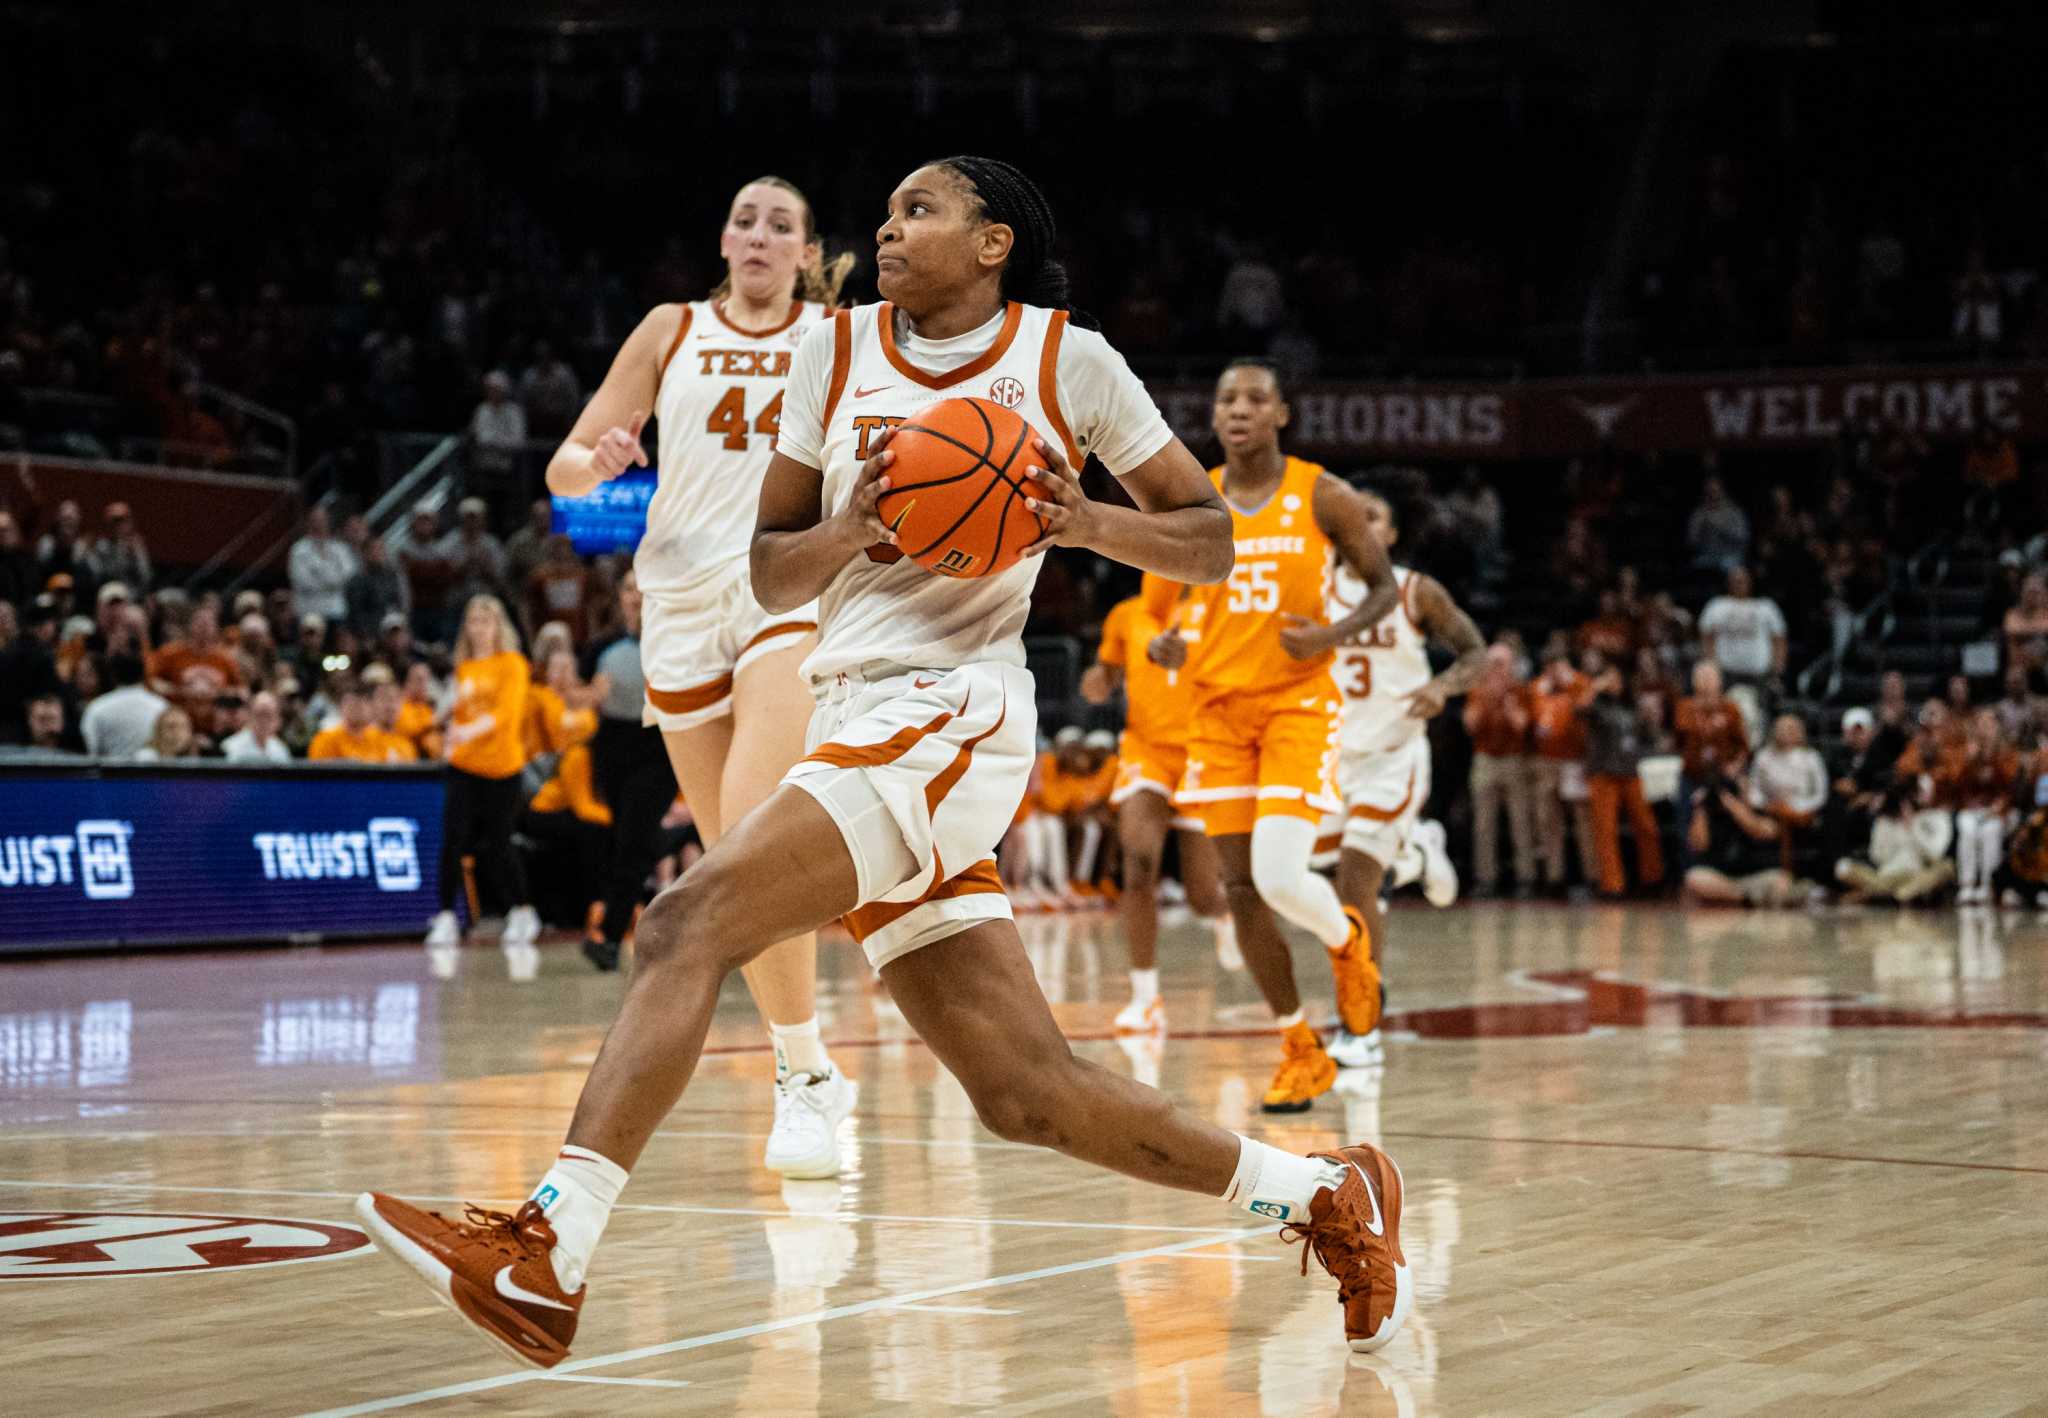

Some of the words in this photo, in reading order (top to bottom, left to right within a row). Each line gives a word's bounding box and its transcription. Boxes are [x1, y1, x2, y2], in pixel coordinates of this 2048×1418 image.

[697, 349, 792, 377] TEXA
[990, 377, 1025, 409] SEC
[1300, 394, 1502, 443] HORNS
[1704, 379, 2021, 438] WELCOME
[1228, 561, 1280, 613] 55
[1345, 653, 1372, 699] 3
[0, 834, 75, 887] UIST
[252, 831, 370, 880] TRUIST
